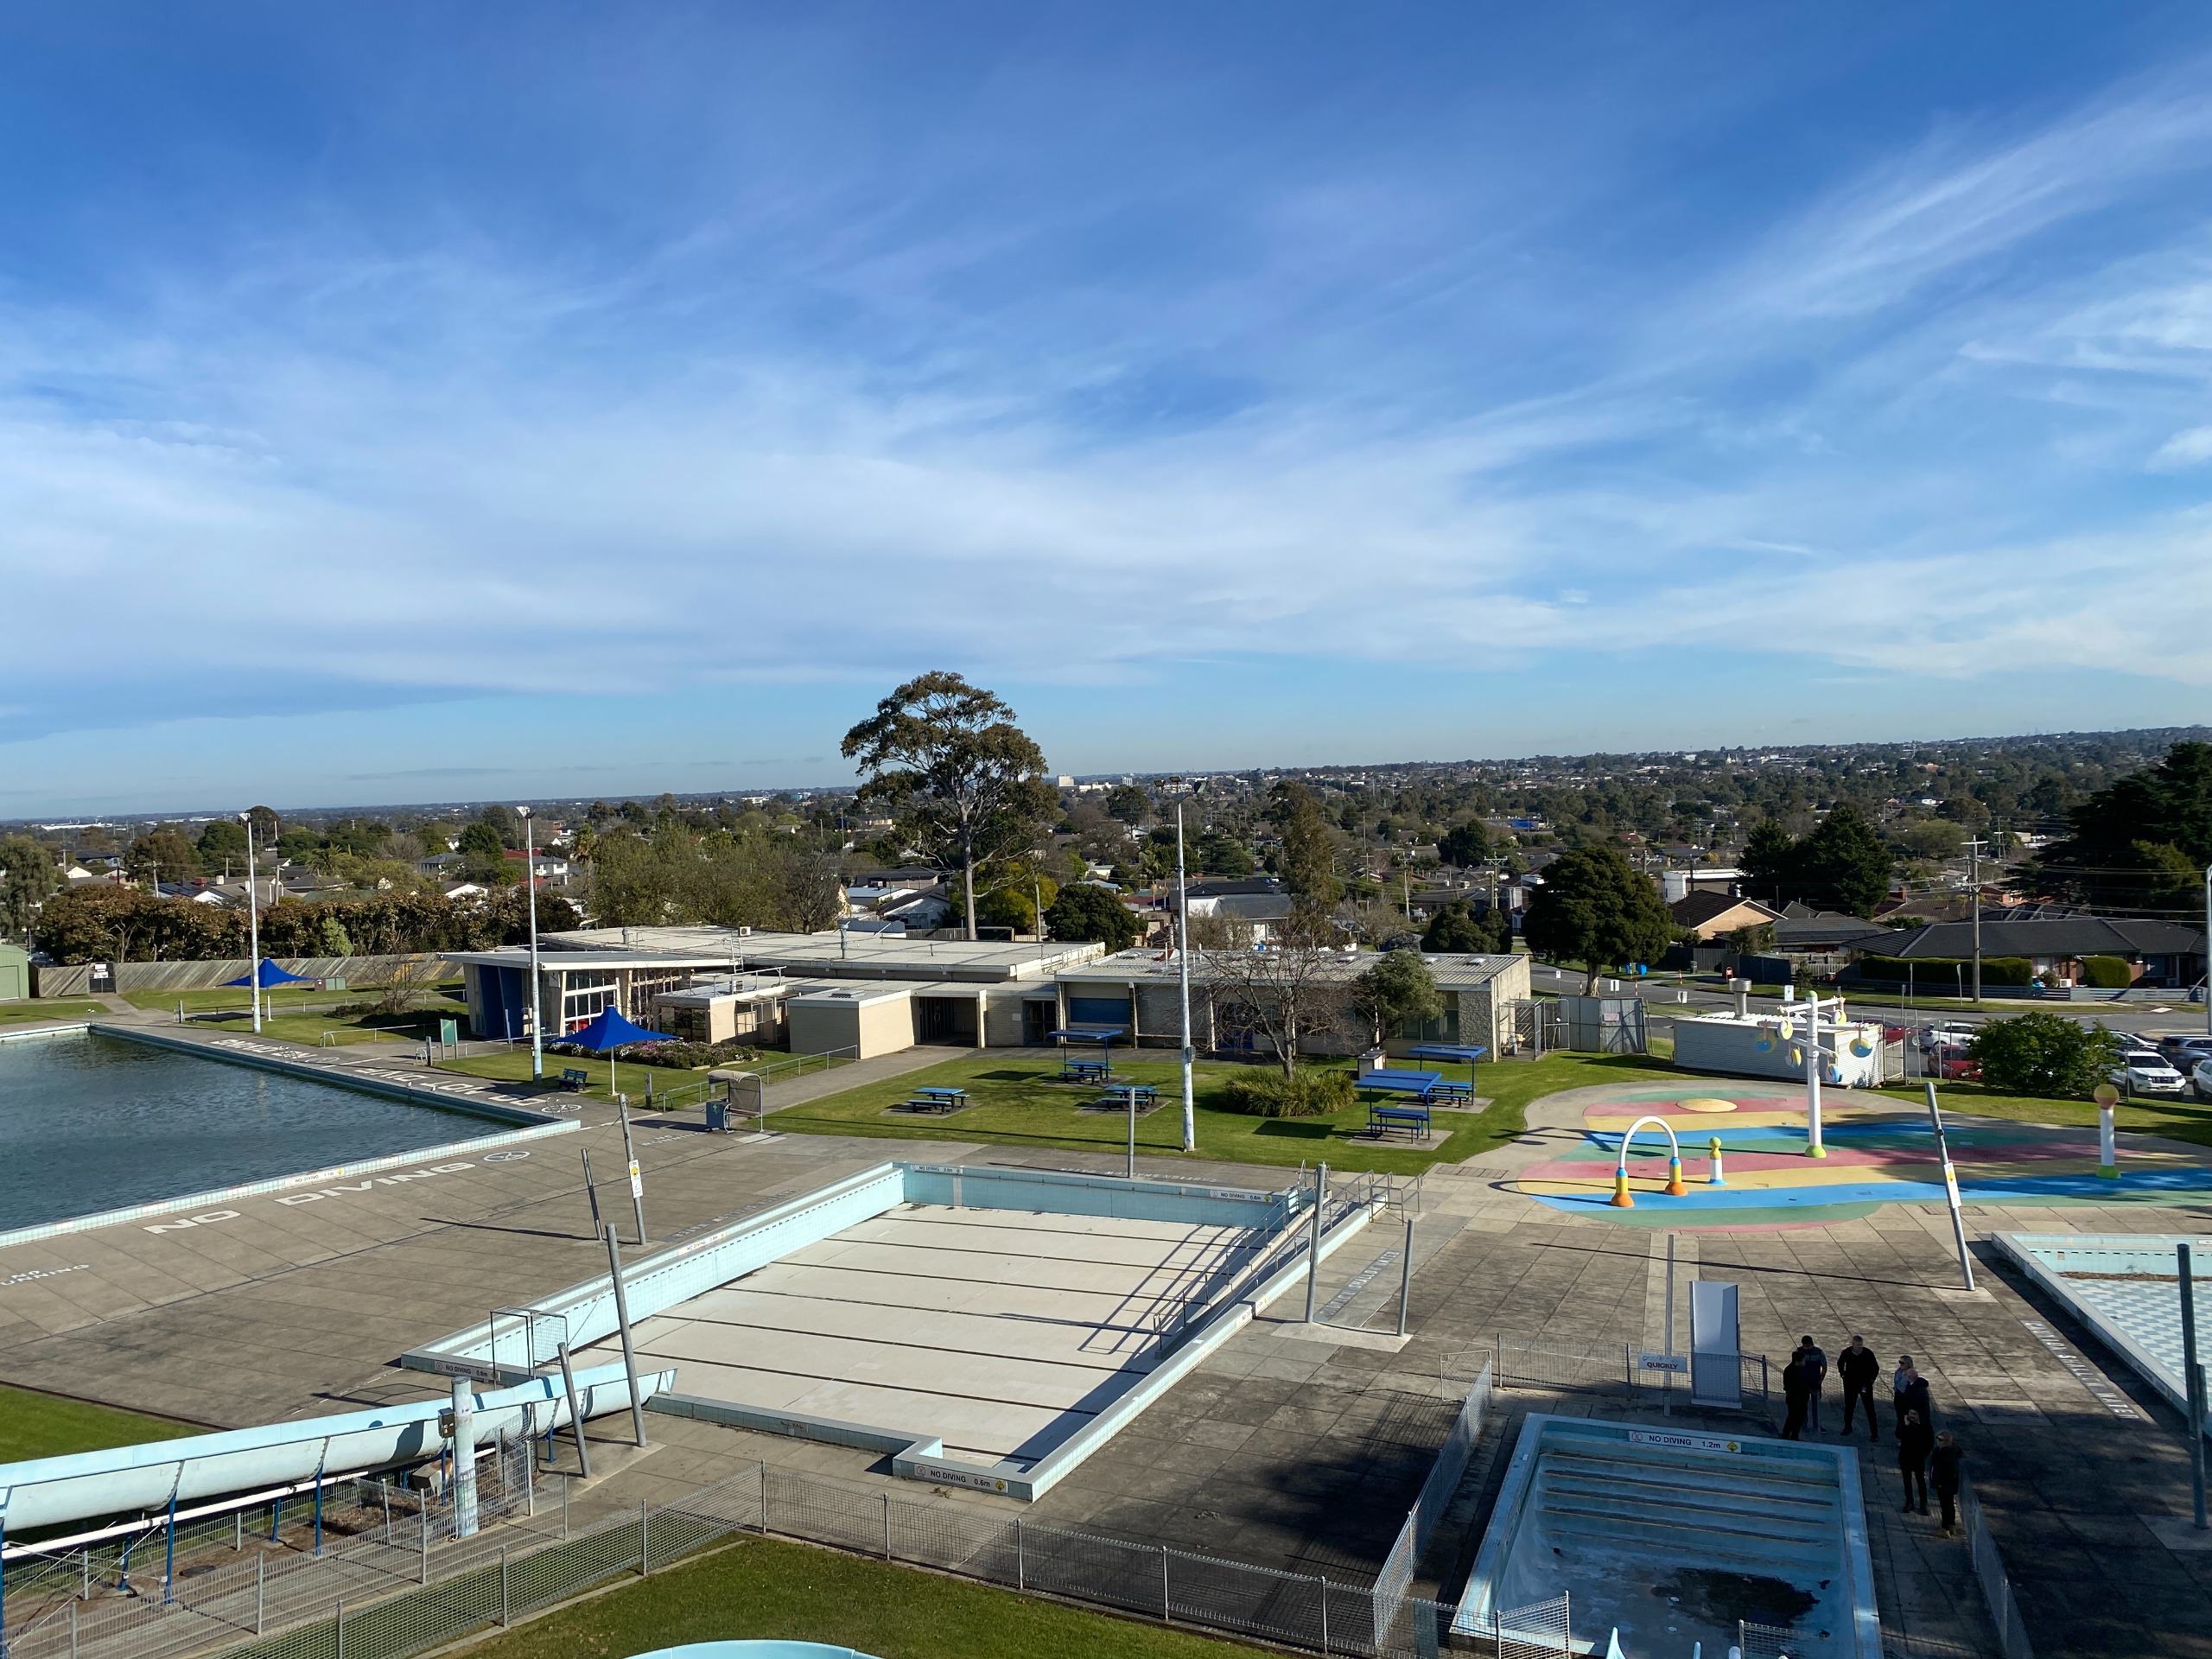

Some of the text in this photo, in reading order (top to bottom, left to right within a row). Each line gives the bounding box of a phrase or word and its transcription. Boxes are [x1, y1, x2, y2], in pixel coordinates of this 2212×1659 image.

[142, 1161, 475, 1234] NO DIVING
[0, 1264, 90, 1286] UNNING
[11, 1270, 41, 1280] NO
[1663, 1436, 1692, 1446] DIVING
[943, 1472, 966, 1483] DIVING
[974, 1478, 990, 1487] 0.6m
